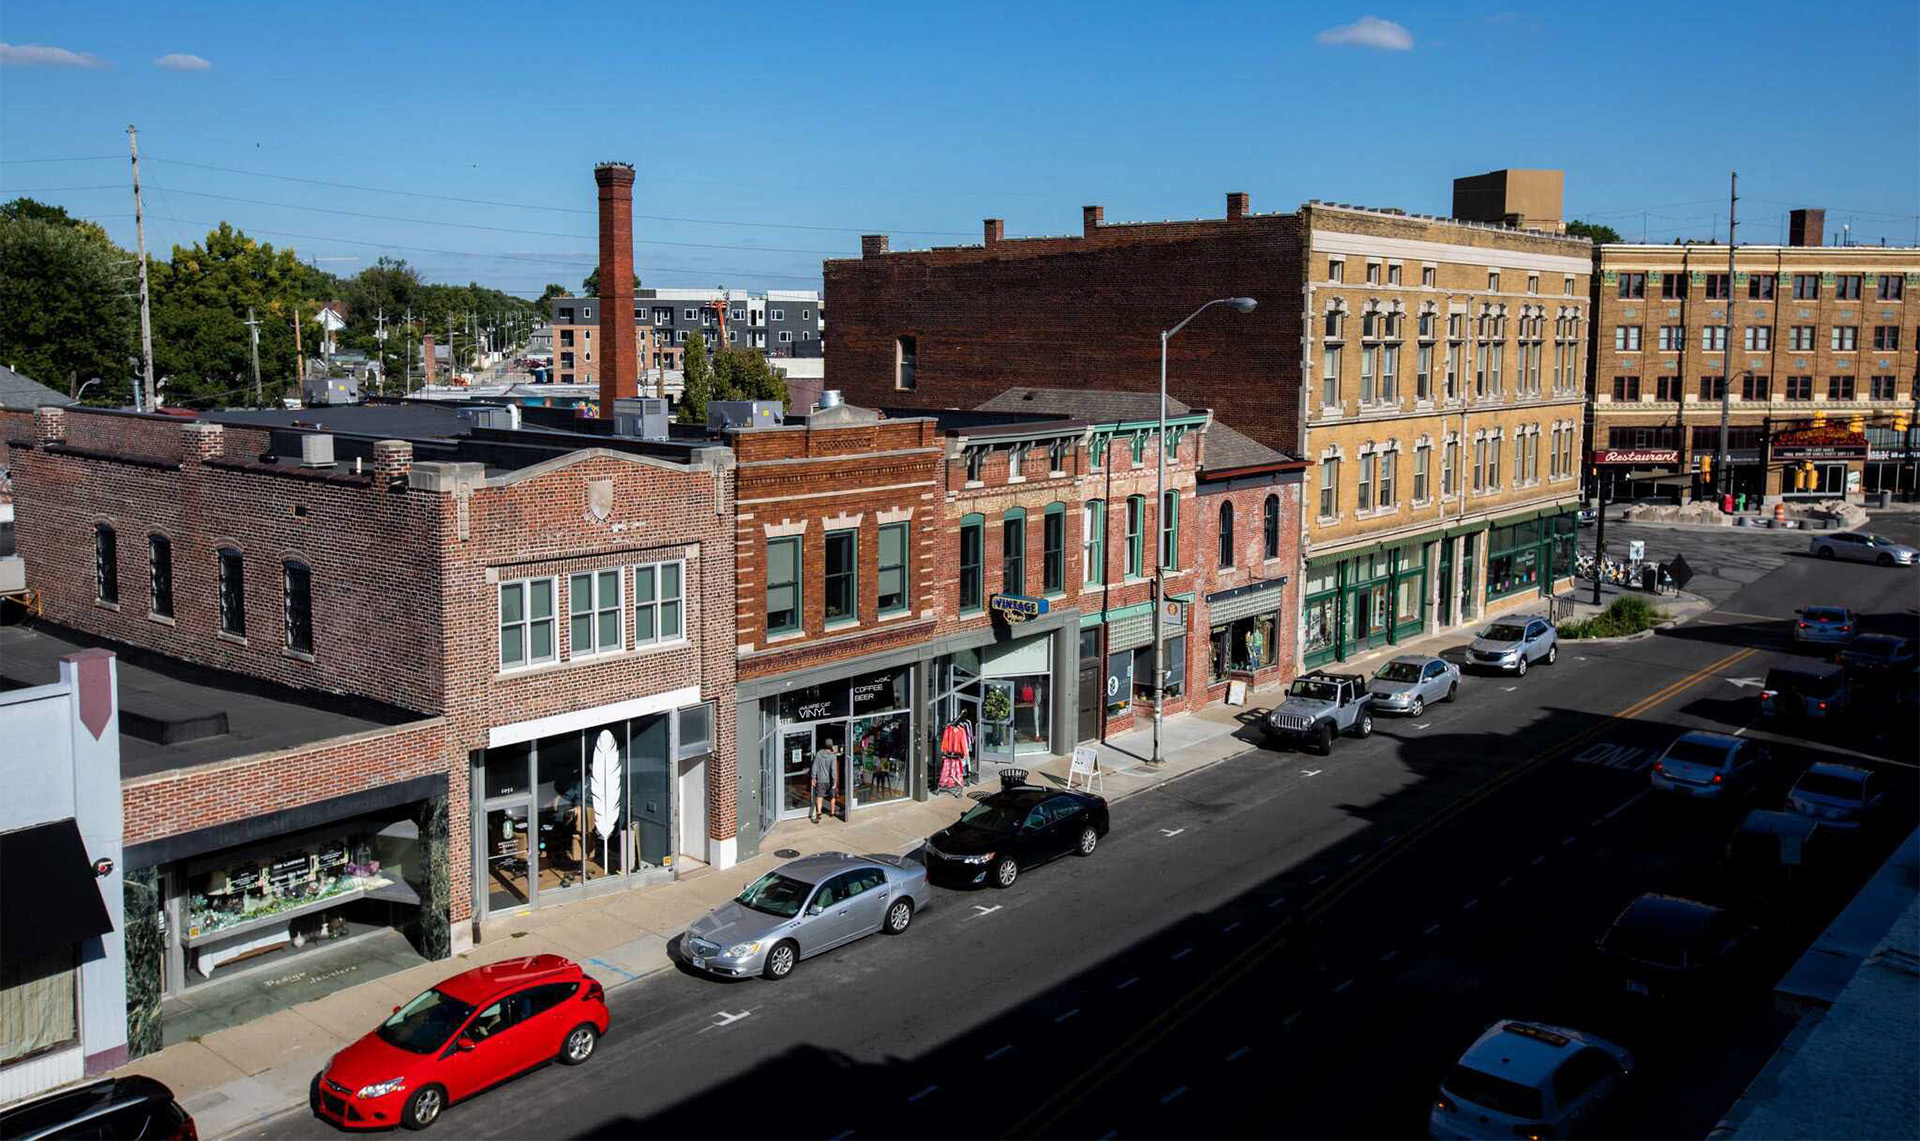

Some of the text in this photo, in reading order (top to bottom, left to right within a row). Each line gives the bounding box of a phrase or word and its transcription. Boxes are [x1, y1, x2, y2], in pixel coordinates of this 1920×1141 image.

[1604, 451, 1678, 462] Restaurant
[993, 598, 1036, 613] VINTAGE
[854, 683, 883, 693] COFFEE
[854, 693, 875, 702] BEER
[798, 707, 832, 719] VINYL
